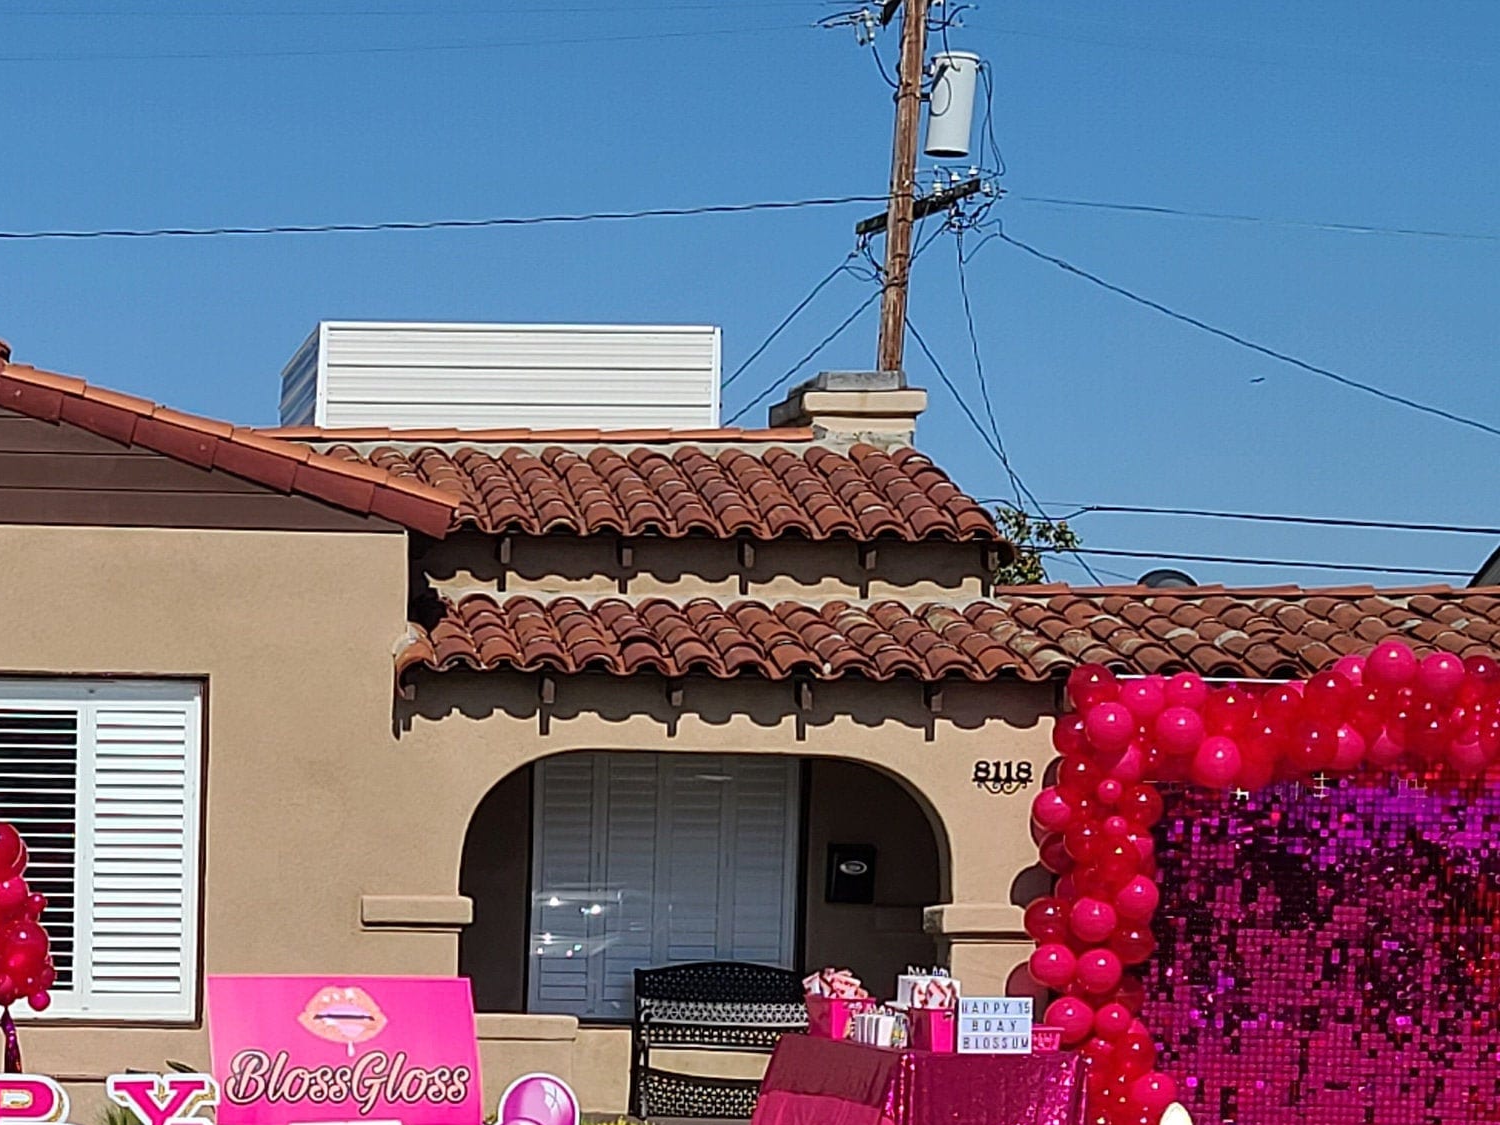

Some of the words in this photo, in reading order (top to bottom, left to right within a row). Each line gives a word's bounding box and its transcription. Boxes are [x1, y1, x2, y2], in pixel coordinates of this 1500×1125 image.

[974, 760, 1033, 784] 8118
[961, 1001, 1009, 1014] HAPPY
[1018, 1001, 1031, 1014] 15
[972, 1019, 1018, 1032] BDAY
[225, 1050, 471, 1115] BlossGloss
